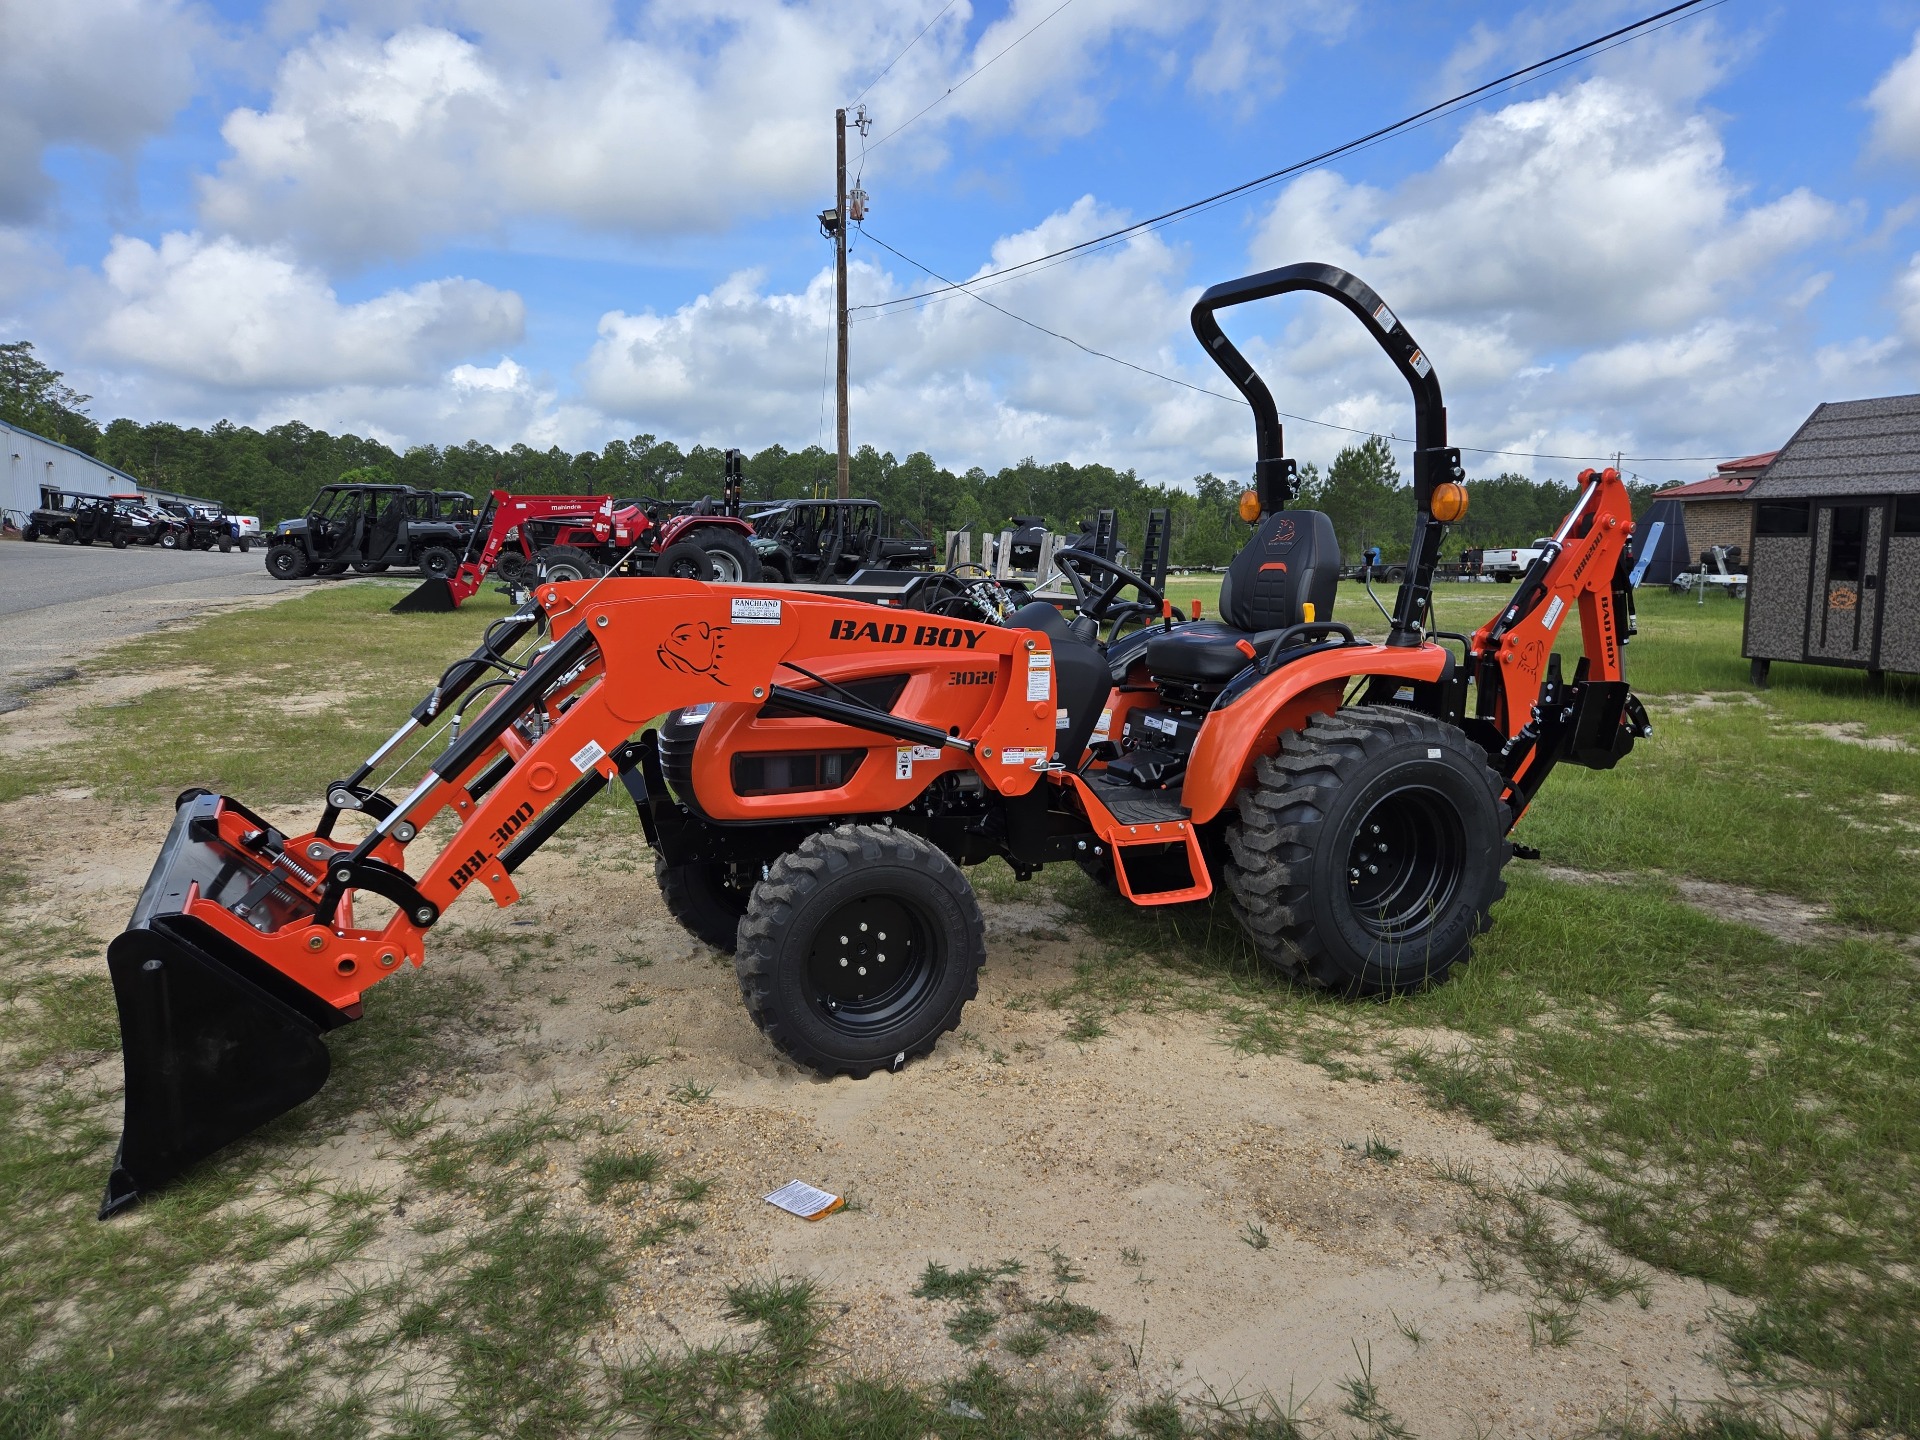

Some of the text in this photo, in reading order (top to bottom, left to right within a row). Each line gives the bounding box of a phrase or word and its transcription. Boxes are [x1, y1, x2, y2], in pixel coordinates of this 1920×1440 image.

[735, 600, 778, 608] RANCHLAND
[829, 619, 987, 649] BAD BOY
[1601, 596, 1616, 669] BAD BOY
[448, 801, 535, 890] BBL 300
